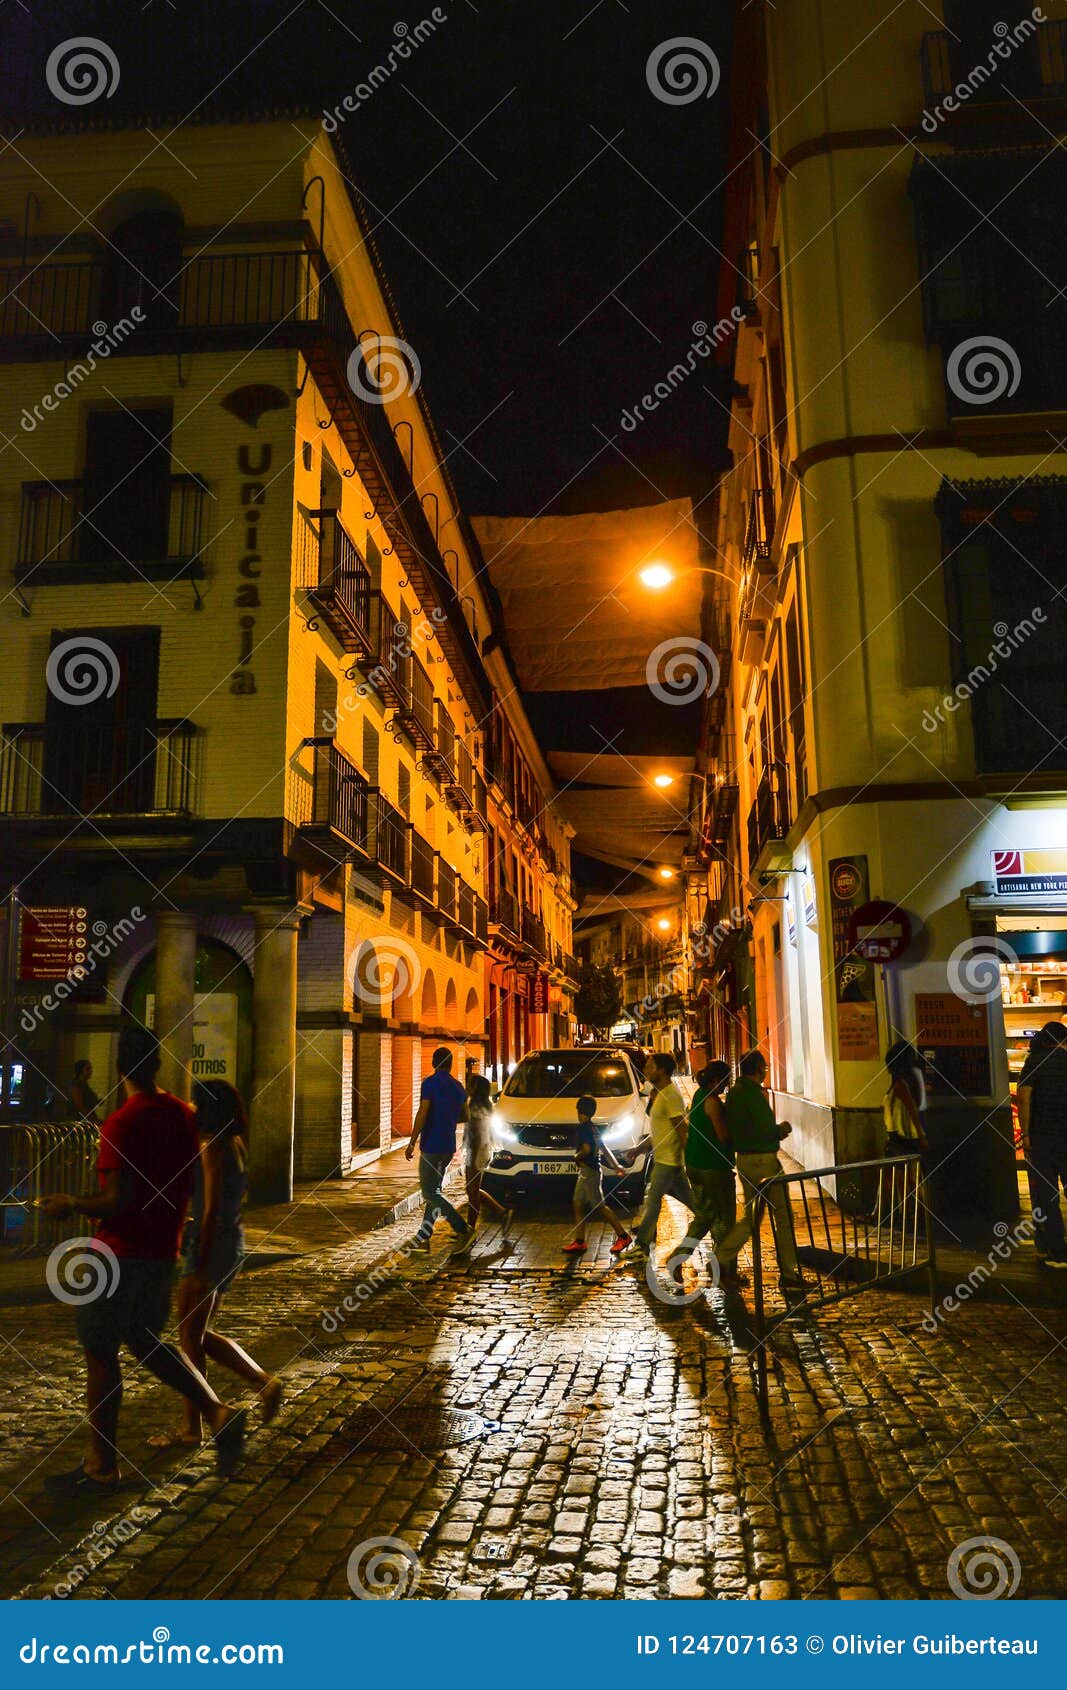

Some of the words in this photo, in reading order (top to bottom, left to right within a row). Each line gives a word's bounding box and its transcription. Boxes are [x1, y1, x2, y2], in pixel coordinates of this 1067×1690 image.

[229, 443, 272, 695] Unicaja
[1000, 883, 1029, 892] ARTISANAL
[1031, 882, 1042, 890] NEW
[1043, 882, 1058, 890] YORK
[539, 1163, 562, 1173] 1667
[565, 1163, 580, 1173] JN
